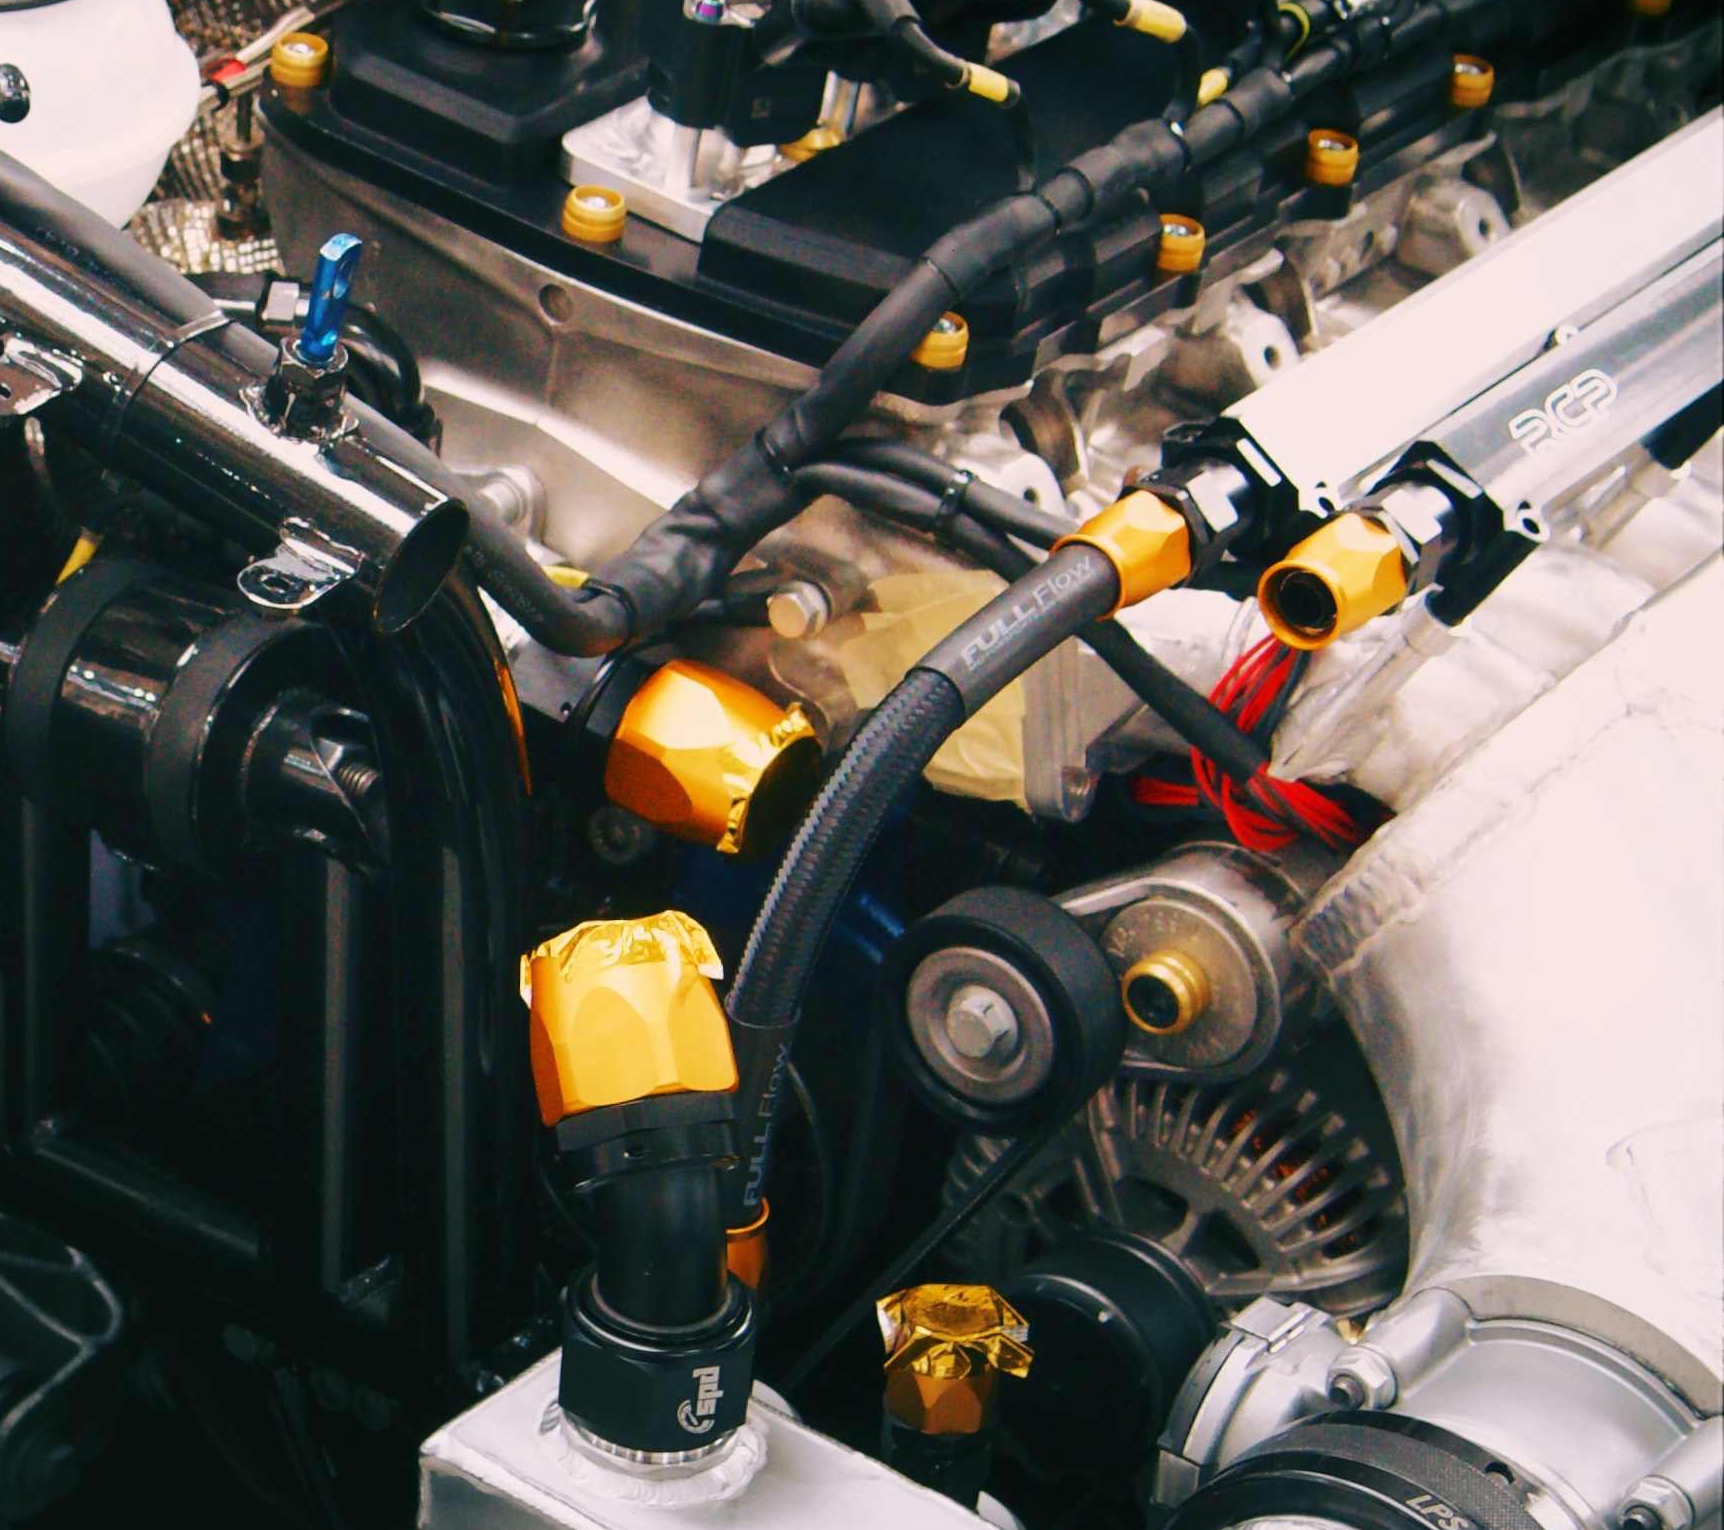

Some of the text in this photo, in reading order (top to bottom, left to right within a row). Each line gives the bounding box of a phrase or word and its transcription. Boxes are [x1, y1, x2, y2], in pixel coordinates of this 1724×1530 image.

[960, 555, 1092, 670] FULL Flow
[743, 1122, 772, 1207] FULL
